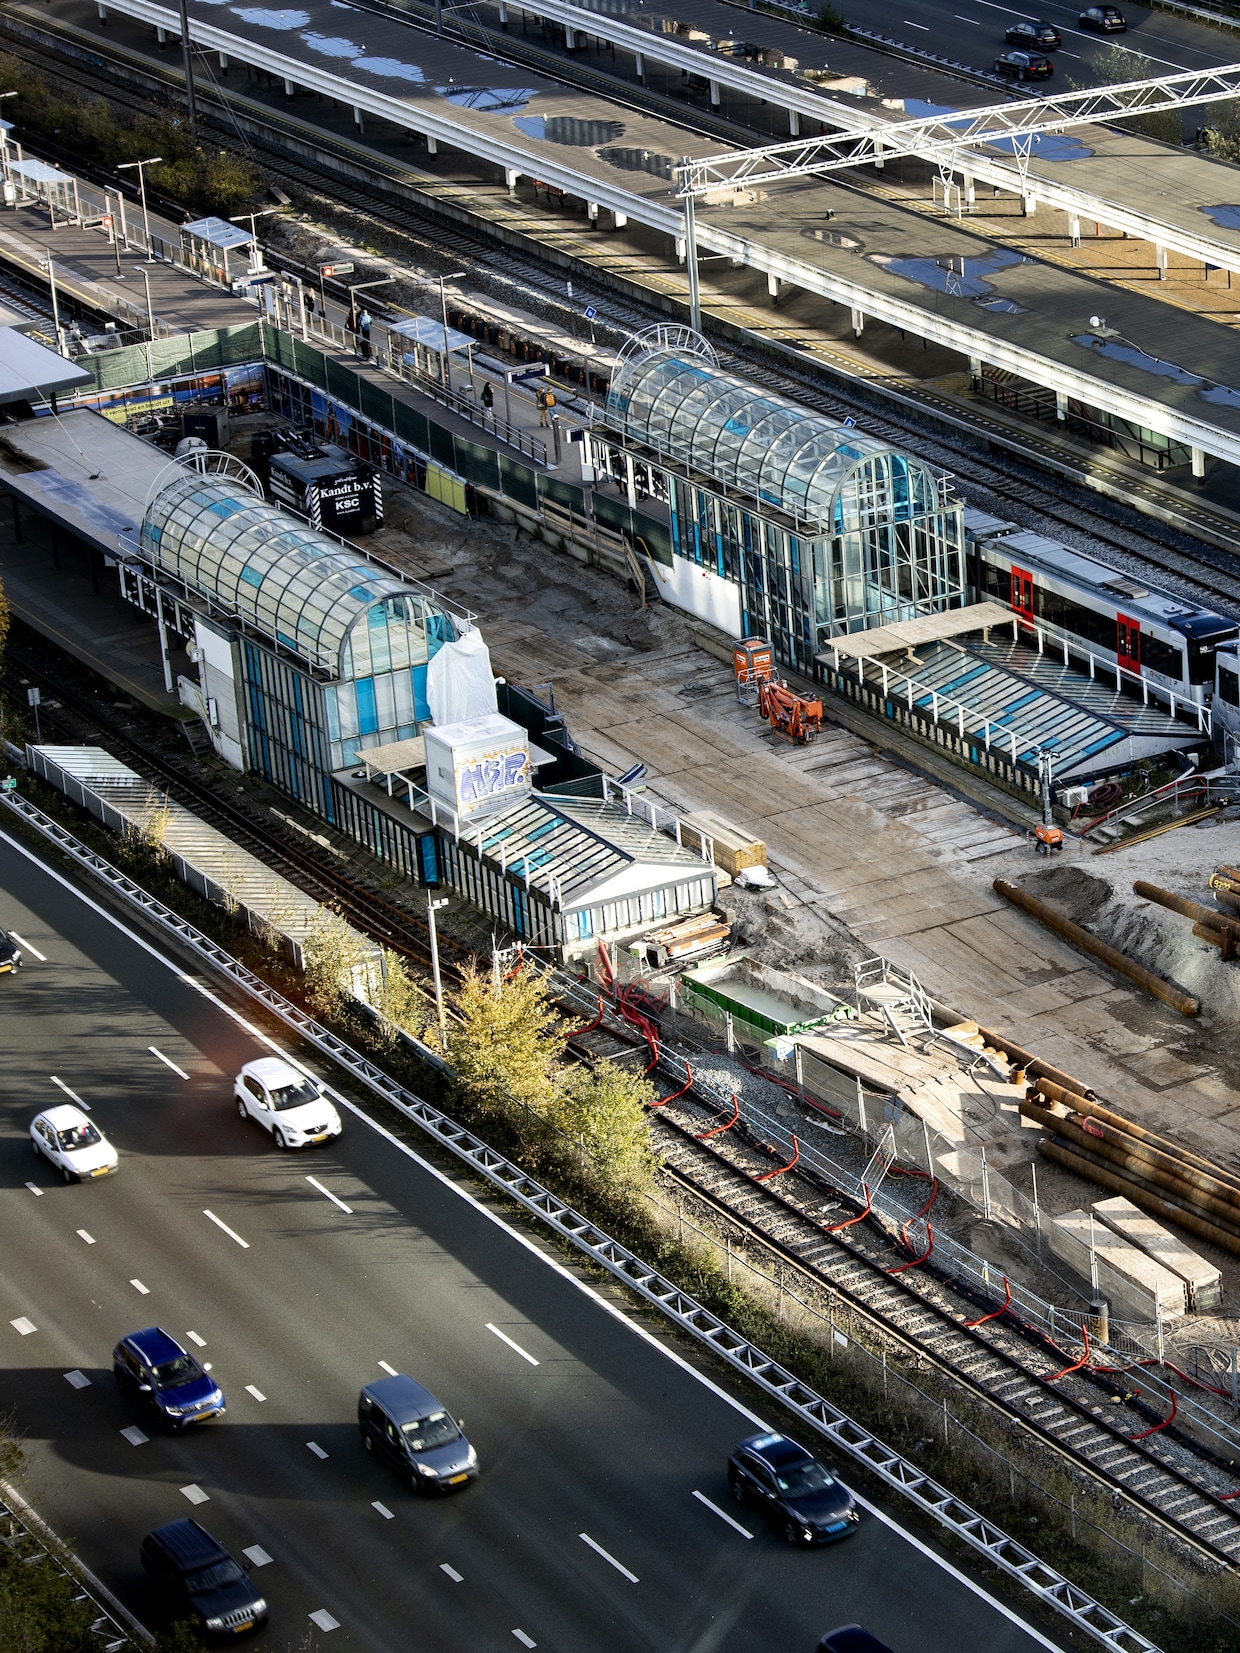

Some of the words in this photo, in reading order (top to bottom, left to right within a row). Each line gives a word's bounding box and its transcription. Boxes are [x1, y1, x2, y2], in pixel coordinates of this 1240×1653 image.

[320, 484, 352, 498] Kandt
[353, 482, 373, 491] b.v.
[335, 498, 360, 510] KSC
